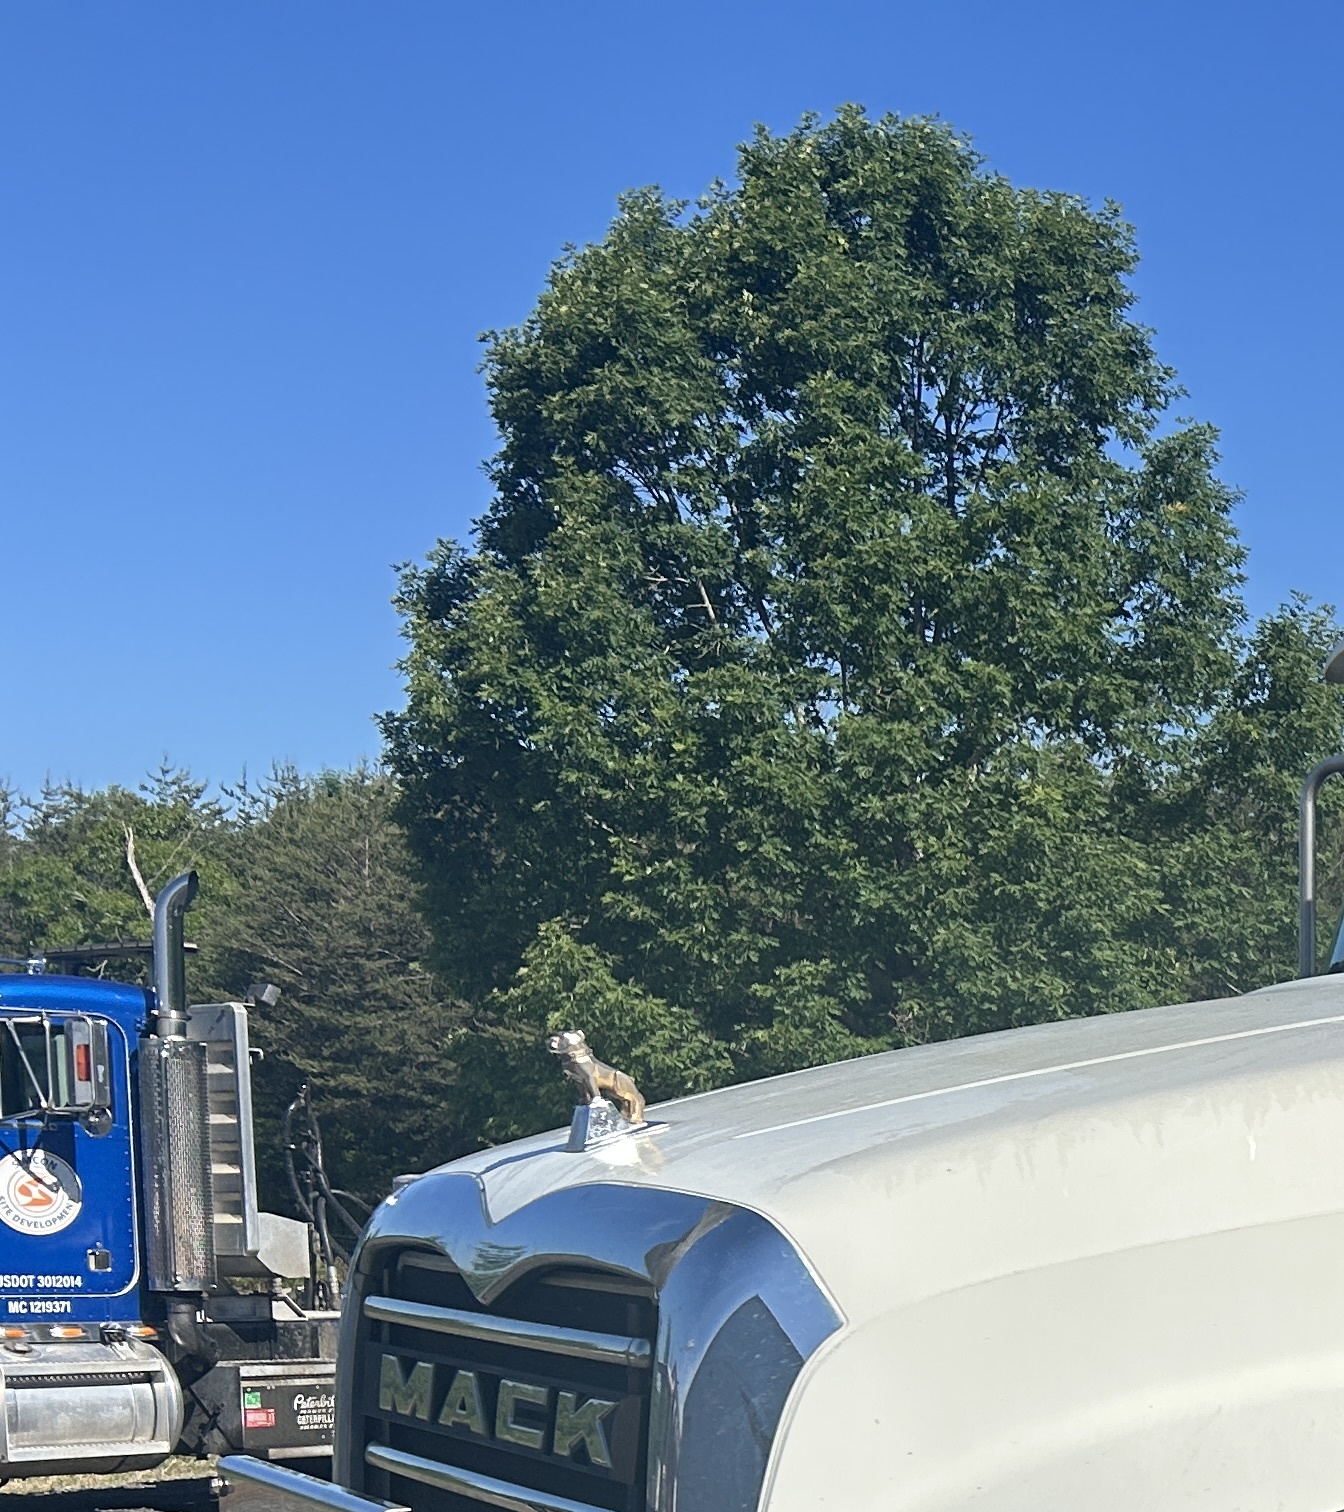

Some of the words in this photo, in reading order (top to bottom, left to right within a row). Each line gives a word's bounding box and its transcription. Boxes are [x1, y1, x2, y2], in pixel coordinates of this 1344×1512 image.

[37, 1275, 83, 1288] 3012014
[8, 1301, 28, 1314] MC
[29, 1301, 71, 1314] 1219371
[379, 1353, 620, 1470] MACK
